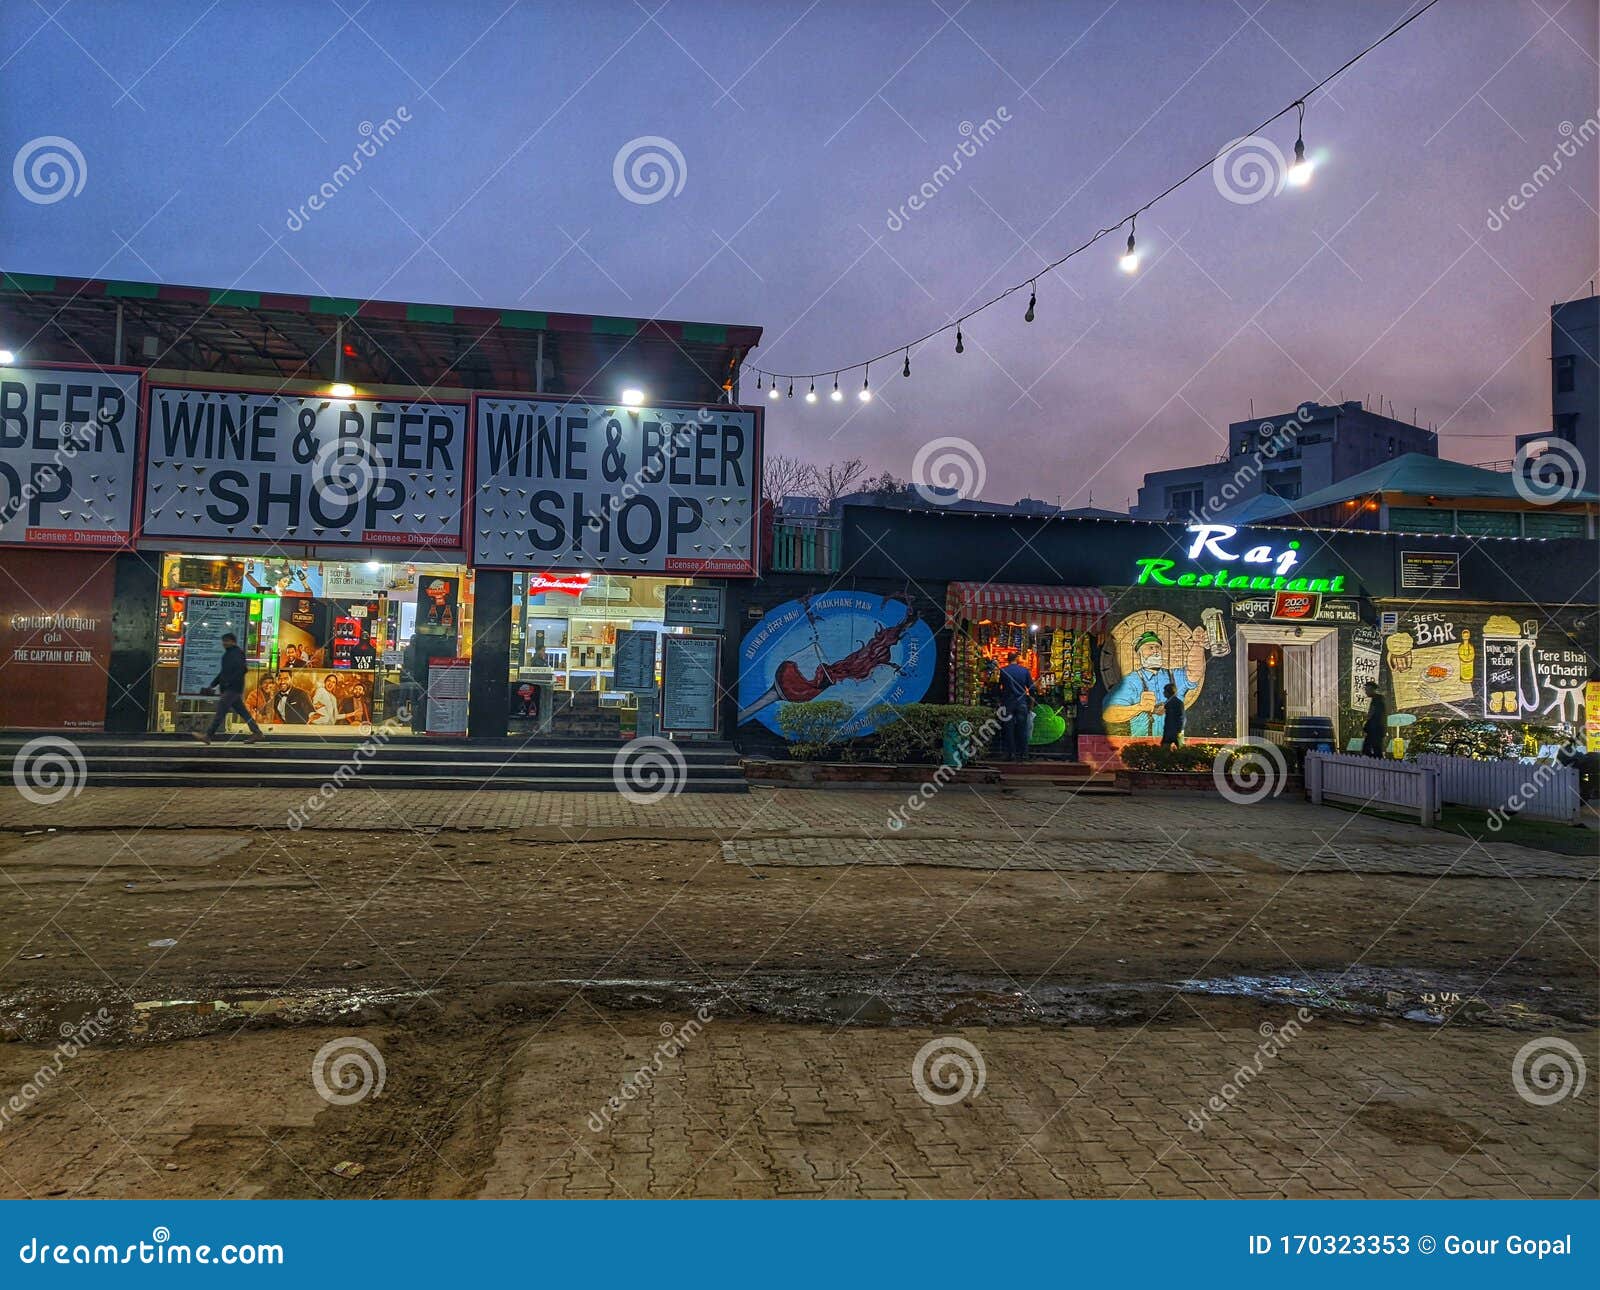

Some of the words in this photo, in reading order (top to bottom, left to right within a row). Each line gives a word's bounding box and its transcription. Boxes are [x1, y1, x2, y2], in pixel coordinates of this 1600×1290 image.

[0, 382, 125, 453] BEER
[160, 400, 279, 462] WINE
[292, 407, 321, 465] &
[337, 411, 455, 471] BEER
[486, 412, 589, 480] WINE
[601, 418, 628, 483] &
[641, 421, 745, 487] BEER
[205, 470, 407, 530] SHOP
[528, 489, 703, 555] SHOP
[29, 531, 67, 541] Licensee
[74, 532, 126, 543] Dharmender
[365, 532, 401, 543] Licensee
[408, 533, 456, 545] Dharmender
[1186, 524, 1300, 575] Raj
[668, 560, 700, 570] Licensee
[705, 560, 748, 571] Dharmender
[1136, 558, 1345, 592] Restaurant
[1284, 598, 1309, 607] 2020
[11, 613, 54, 632] Captain
[55, 612, 96, 632] Morgan
[1336, 612, 1356, 620] PLACE
[1414, 622, 1456, 645] BAR
[14, 650, 28, 660] THE
[30, 650, 62, 662] CAPTAIN
[64, 650, 73, 662] OF
[76, 650, 91, 662] FUN
[1538, 650, 1560, 662] Tere
[1564, 651, 1586, 663] Bhai
[1538, 664, 1550, 674] Ko
[1552, 664, 1588, 676] Chadti
